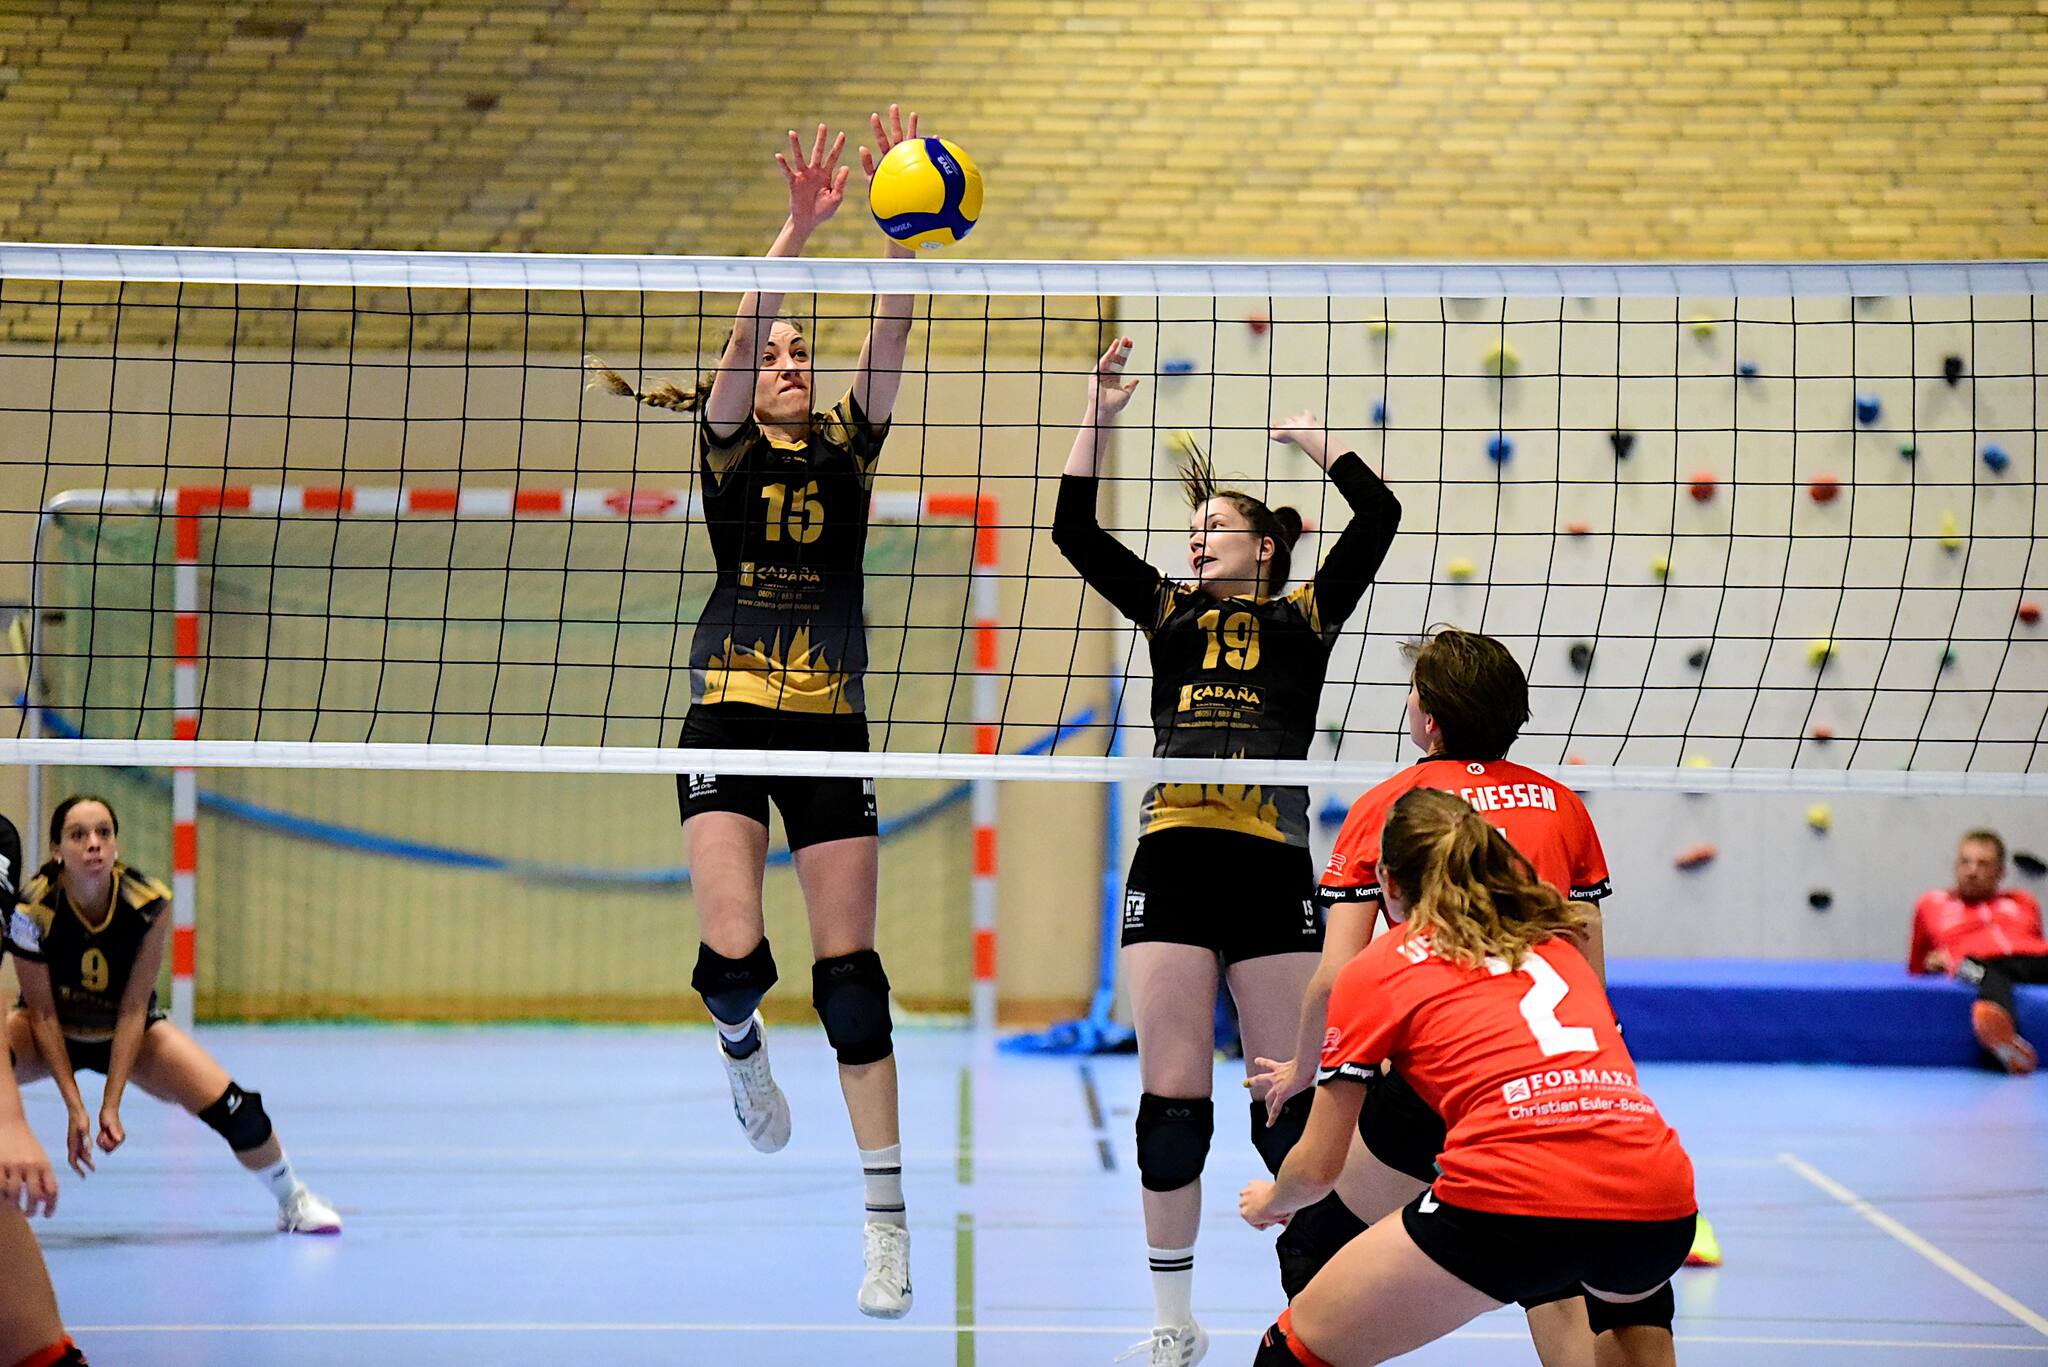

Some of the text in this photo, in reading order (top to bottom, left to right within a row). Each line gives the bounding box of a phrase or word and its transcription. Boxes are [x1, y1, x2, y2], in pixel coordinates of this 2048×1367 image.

[761, 480, 824, 543] 15
[1197, 609, 1260, 670] 19
[1192, 685, 1260, 704] CABAÑA
[1461, 783, 1558, 812] GIESSEN
[1320, 887, 1346, 900] Kempa
[1569, 888, 1602, 899] Kempa
[81, 948, 109, 992] 9
[1484, 950, 1599, 1057] 2
[1508, 1098, 1579, 1121] Christian
